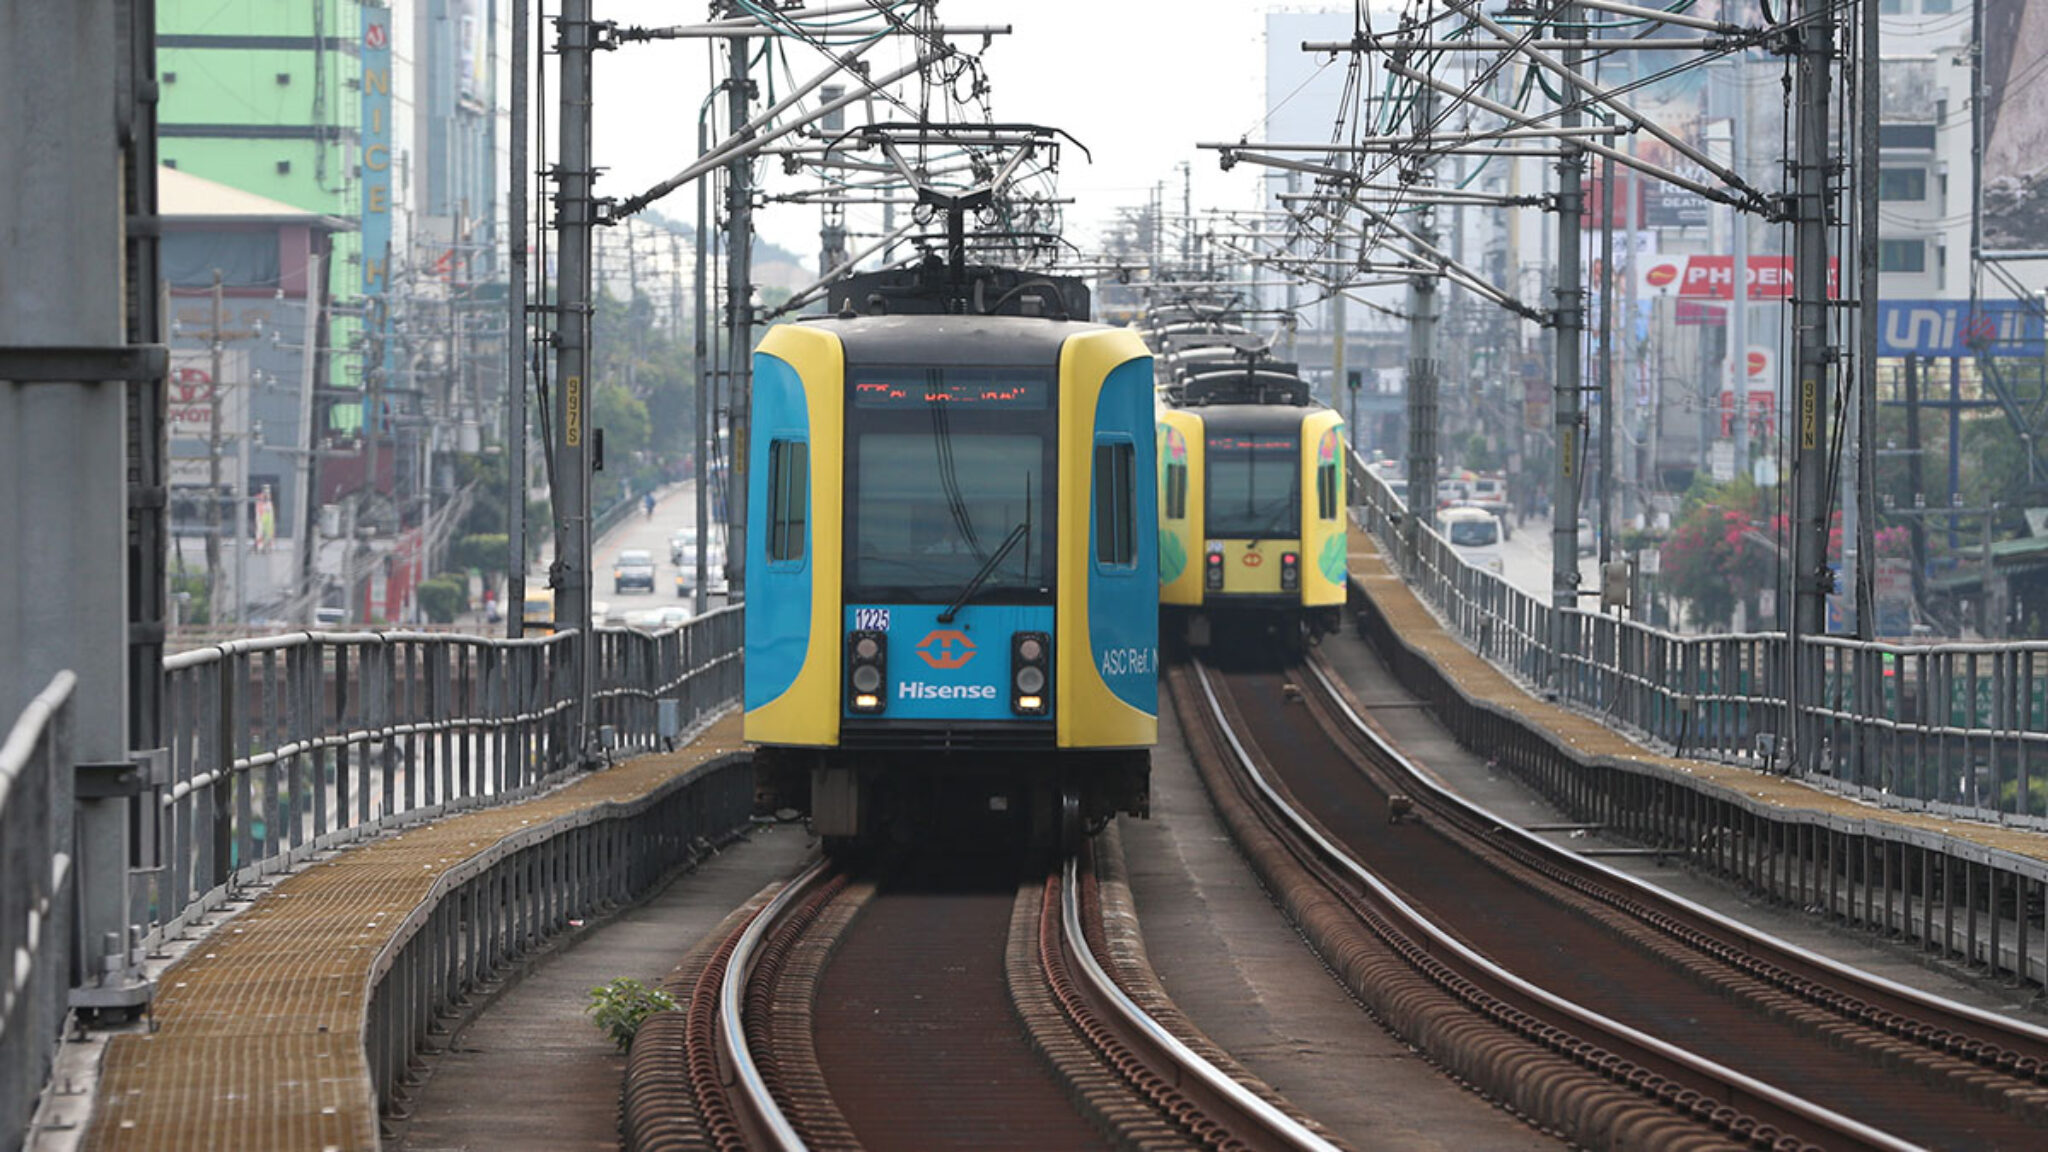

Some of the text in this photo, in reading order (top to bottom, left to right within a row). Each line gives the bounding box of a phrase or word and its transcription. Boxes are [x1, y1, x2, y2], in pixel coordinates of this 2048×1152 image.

[364, 67, 388, 214] NICE
[1687, 266, 1836, 285] PHEN
[1804, 381, 1814, 447] 997N
[856, 609, 889, 631] 1225
[1102, 648, 1127, 676] ASC
[899, 681, 997, 699] Hisense
